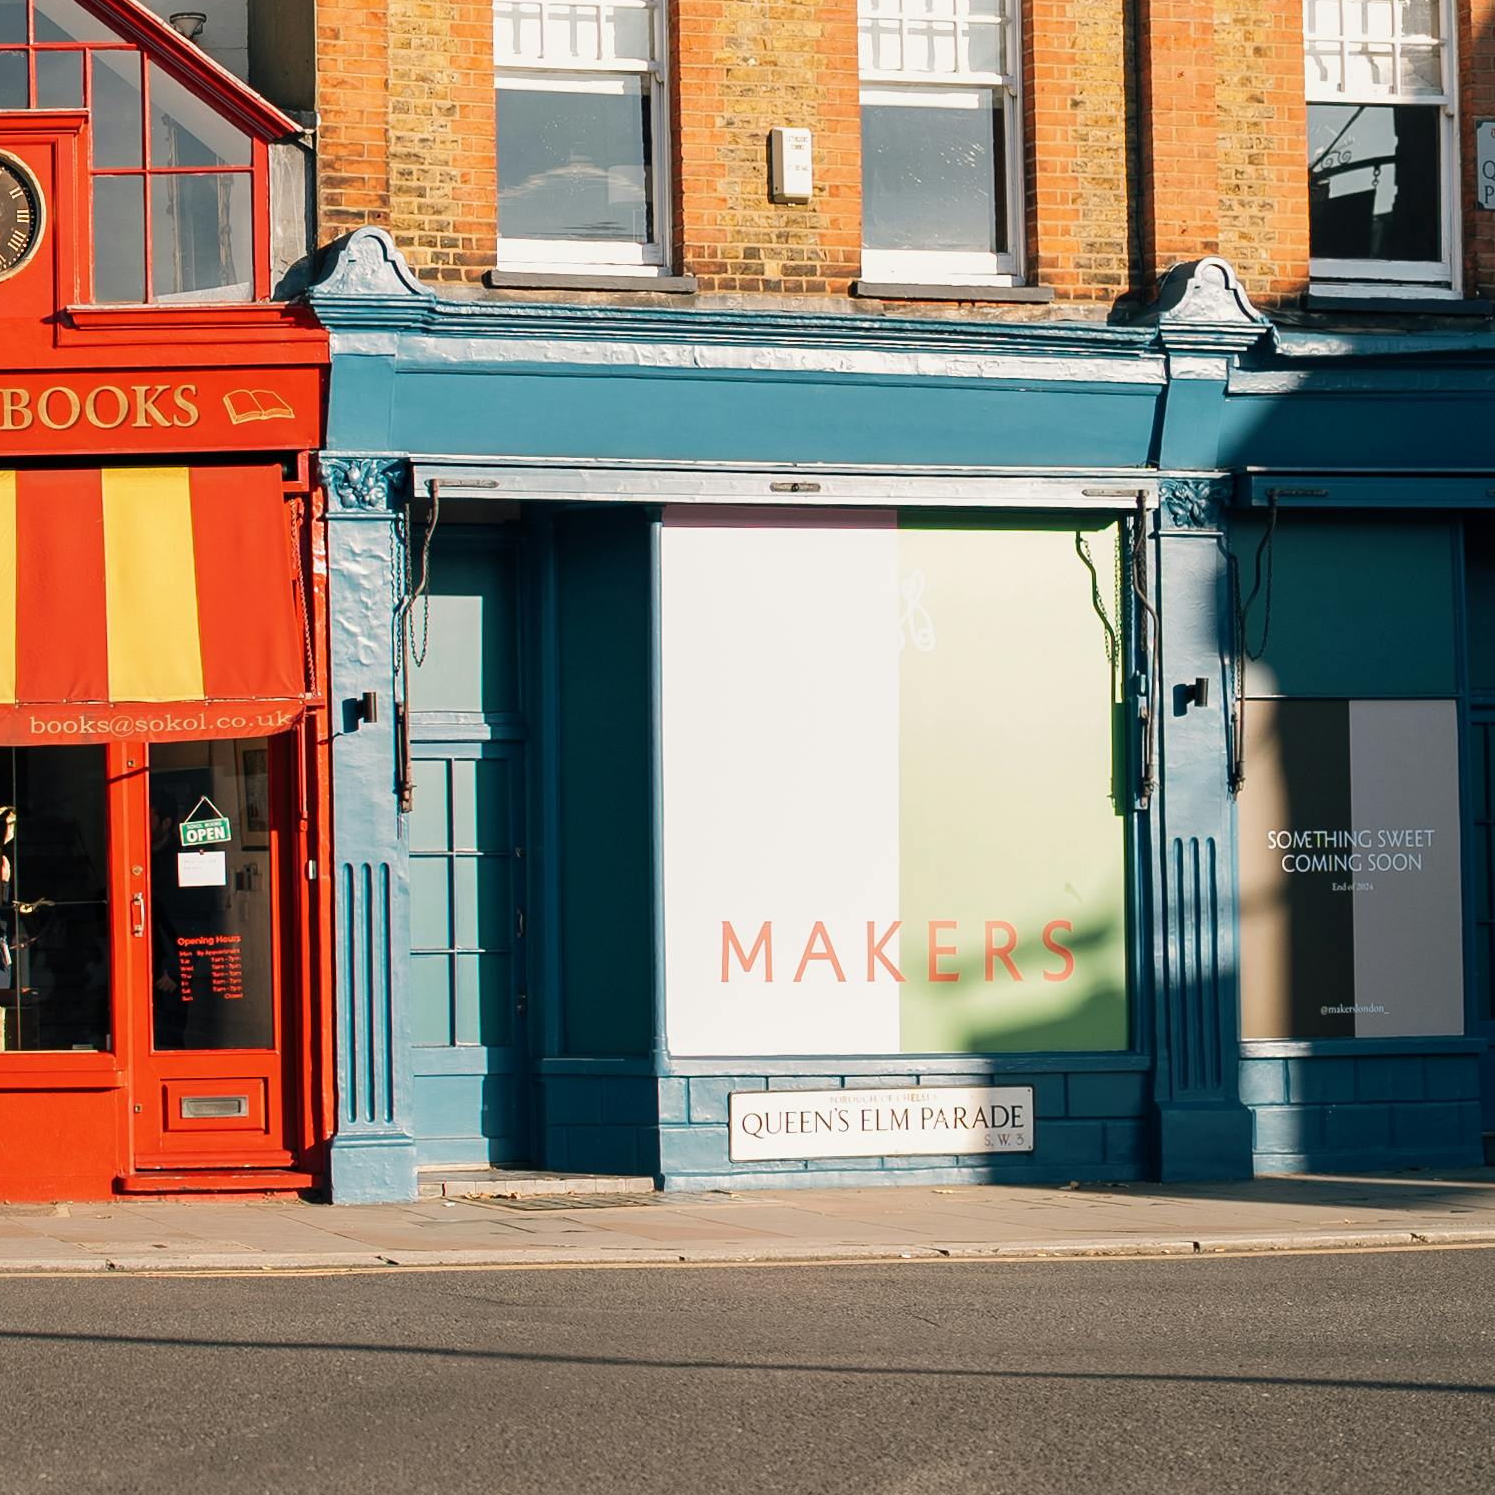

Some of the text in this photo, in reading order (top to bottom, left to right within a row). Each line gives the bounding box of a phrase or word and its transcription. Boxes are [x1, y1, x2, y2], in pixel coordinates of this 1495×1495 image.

[9, 187, 24, 199] II
[17, 209, 30, 223] III
[8, 230, 26, 252] IIII
[29, 711, 293, 737] books@sokol.co.uk
[186, 827, 225, 842] OPEN
[1267, 829, 1435, 849] SOMETHING SWEET
[1282, 853, 1422, 873] COMING SOON
[1332, 882, 1346, 891] End
[177, 935, 241, 947] Opening Hours
[721, 919, 1075, 983] MAKERS
[742, 1105, 1025, 1139] QUEEN'S ELM PARADE
[984, 1133, 1024, 1146] S. W. 3
